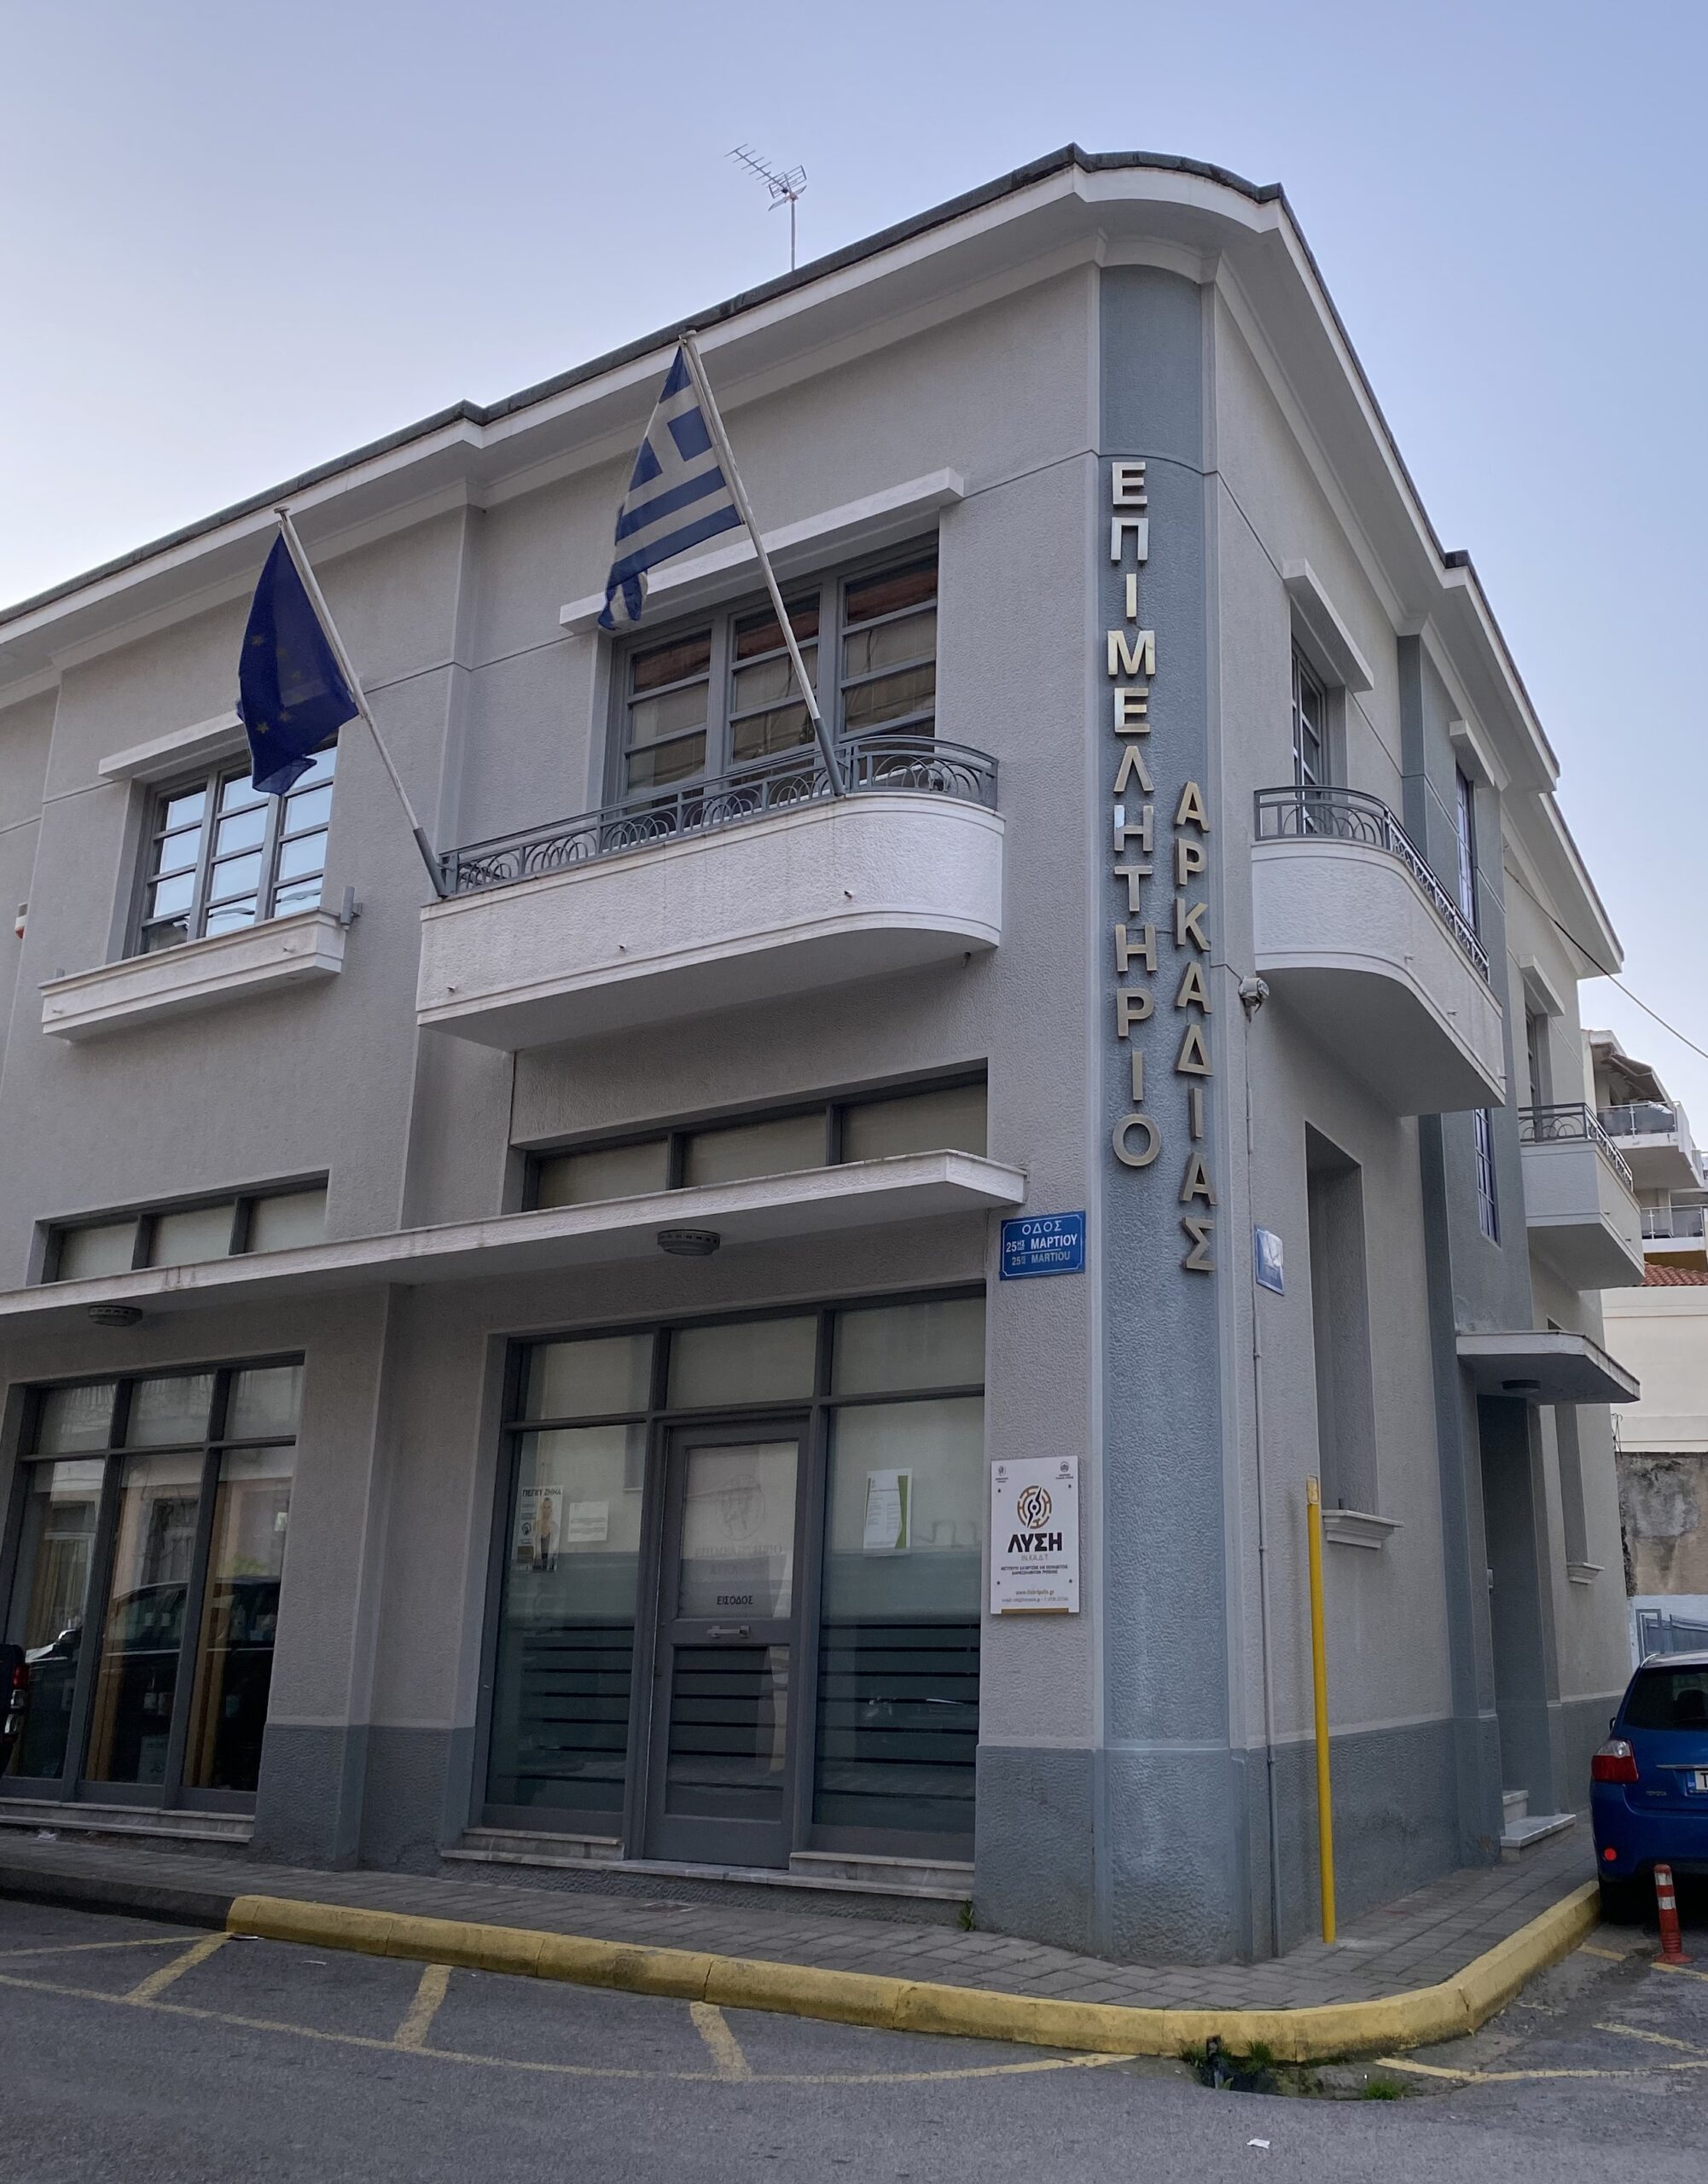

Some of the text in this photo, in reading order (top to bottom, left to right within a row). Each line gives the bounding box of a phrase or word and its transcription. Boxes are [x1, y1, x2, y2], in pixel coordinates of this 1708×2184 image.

[1107, 461, 1162, 1168] ΕΠΙΜΕΛΗΤΗΡΙΟ
[1174, 781, 1217, 1272] ΑΡΚΑΔΙΑΣ
[1022, 1220, 1062, 1235] ΟΔΟΣ
[1031, 1234, 1078, 1250] ΜΑΡΤΙΟΥ
[1031, 1252, 1071, 1264] MARTIOU
[1008, 1532, 1063, 1554] ΛΥΣΗ
[717, 1595, 753, 1606] ΕΙΣΟΔΟΣ
